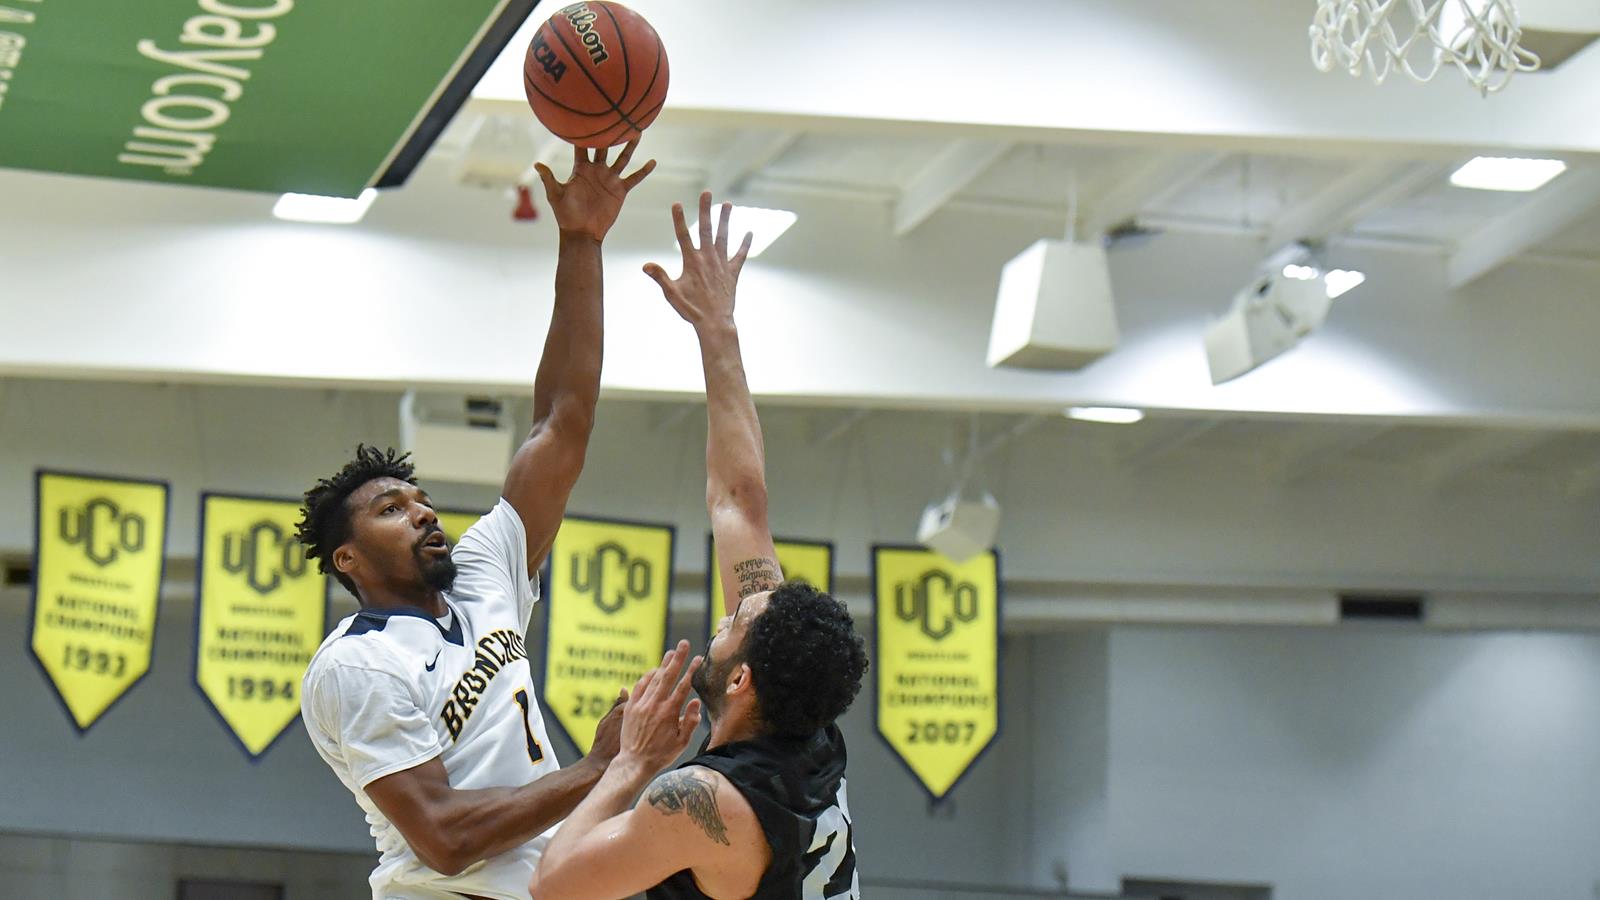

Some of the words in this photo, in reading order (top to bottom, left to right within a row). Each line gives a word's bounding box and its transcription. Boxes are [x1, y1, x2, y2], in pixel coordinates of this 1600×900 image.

[59, 497, 146, 567] UCO
[221, 520, 308, 595] UCO
[570, 541, 653, 614] UCO
[894, 568, 979, 641] UCO
[227, 676, 295, 702] 1994
[555, 660, 647, 686] CHAMPION
[571, 691, 618, 718] 20
[513, 686, 544, 764] 1
[905, 719, 976, 746] 2007
[801, 804, 860, 900] 2
